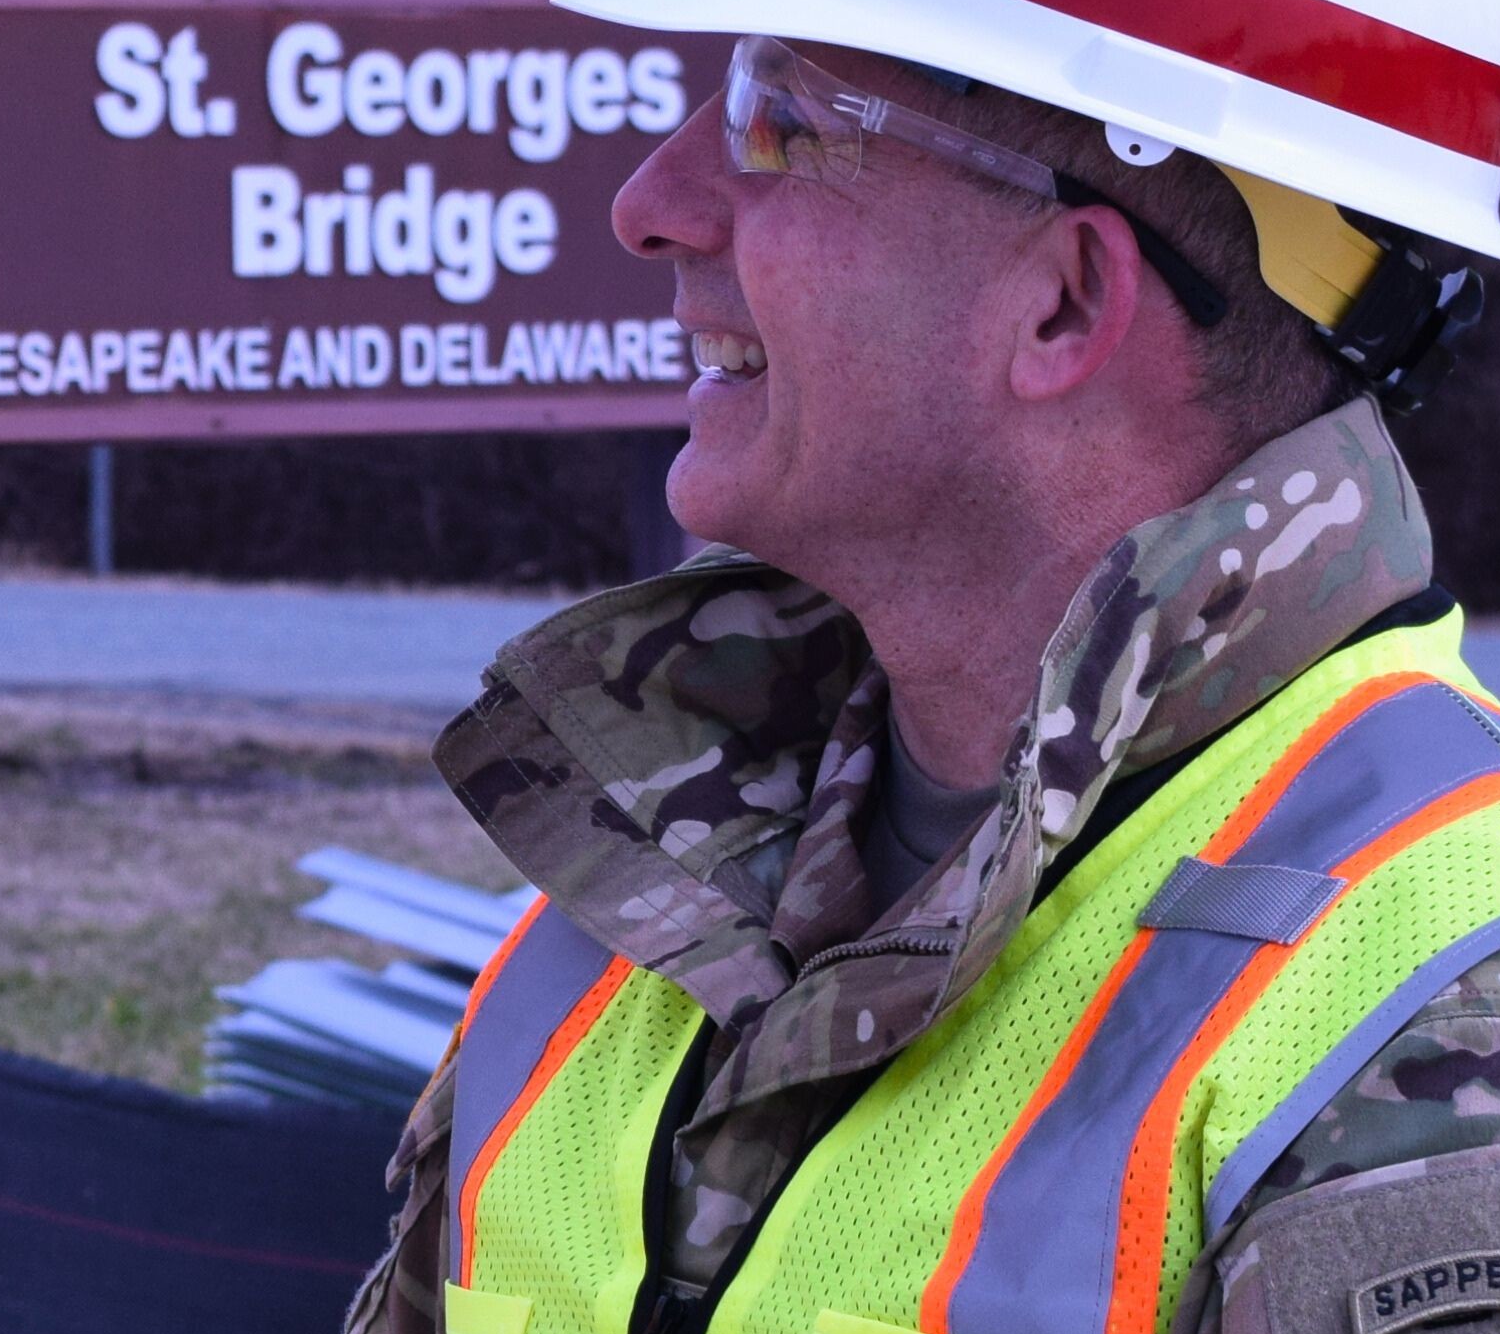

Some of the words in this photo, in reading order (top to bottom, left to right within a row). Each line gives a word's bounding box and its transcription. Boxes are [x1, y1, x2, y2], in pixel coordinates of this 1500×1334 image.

[94, 20, 238, 140] St.
[265, 20, 688, 164] Georges
[230, 162, 559, 306] Bridge
[278, 325, 393, 391] AND
[400, 319, 688, 388] DELAWARE
